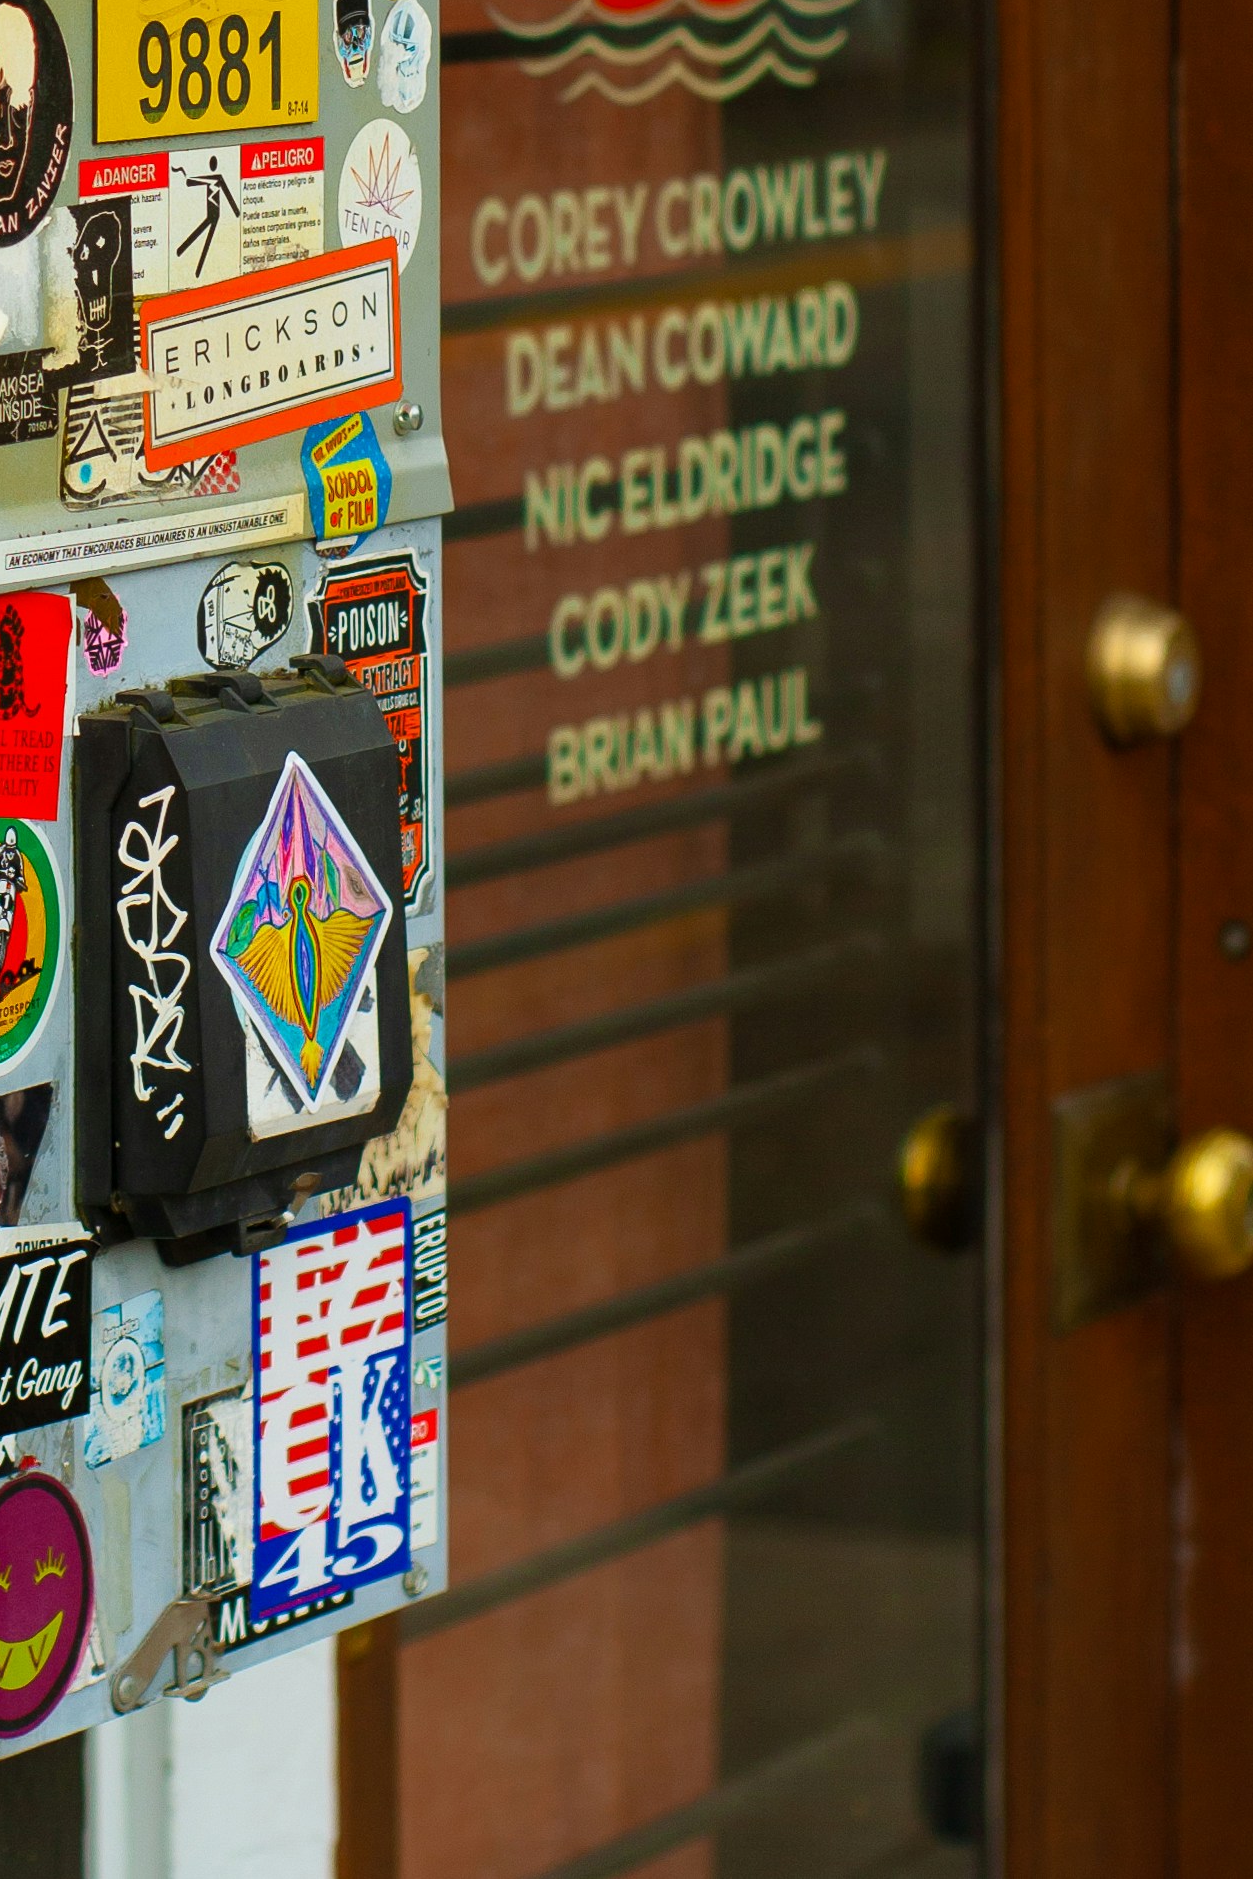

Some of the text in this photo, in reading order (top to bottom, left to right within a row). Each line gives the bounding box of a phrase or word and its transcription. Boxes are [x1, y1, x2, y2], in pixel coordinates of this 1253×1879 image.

[138, 10, 282, 124] 9881
[287, 100, 309, 116] 8-7-14
[25, 122, 67, 220] ZAVIER
[103, 163, 156, 187] DANGER
[262, 147, 315, 169] PELIGRO
[288, 176, 307, 188] peligro
[308, 175, 315, 184] de
[344, 209, 370, 237] TEN
[472, 150, 887, 285] COREY CROWLEY
[165, 292, 377, 374] ERICKSON
[506, 282, 859, 417] DEAN COWARD
[19, 373, 45, 396] SEA
[186, 343, 361, 410] LONGBOARDS
[326, 468, 373, 503] SCHOOL
[522, 412, 847, 553] NIC ELDRIDGE
[8, 511, 285, 568] AN ECONOMY THAT ENCOURAGES BILLIONAIRES IS AN UNSUSTAINABLE ONE
[330, 497, 374, 530] of FILM
[337, 599, 400, 654] POISON
[548, 543, 820, 679] CODY ZEEK
[360, 656, 415, 691] EXTRACT
[12, 728, 55, 749] TREAD
[43, 755, 55, 773] IS
[548, 667, 824, 806] BRIAN PAUL
[16, 1356, 85, 1411] Gang
[258, 1523, 406, 1599] 45
